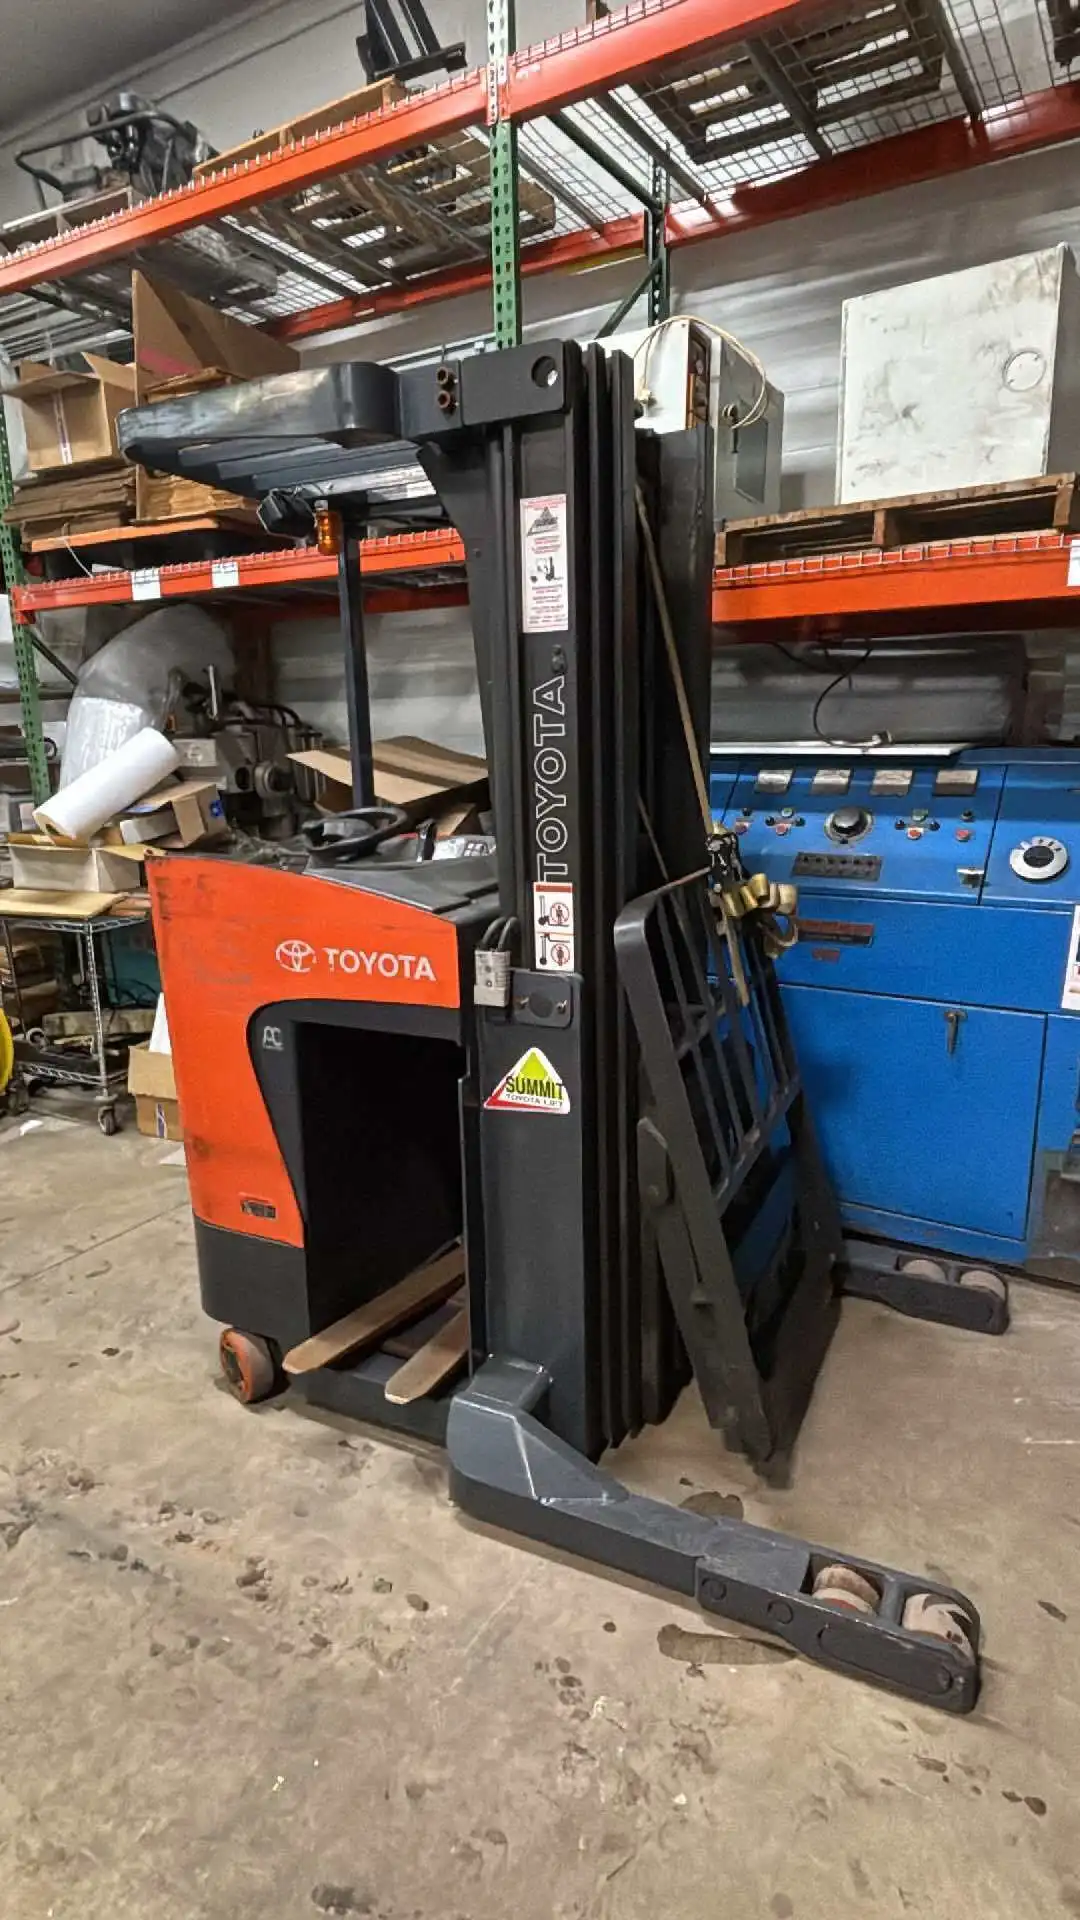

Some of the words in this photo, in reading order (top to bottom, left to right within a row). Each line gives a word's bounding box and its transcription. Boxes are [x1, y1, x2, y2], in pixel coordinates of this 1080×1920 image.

[533, 675, 568, 883] TOYOTA
[322, 947, 437, 982] TOYOTA
[505, 1075, 563, 1099] SUMMIT
